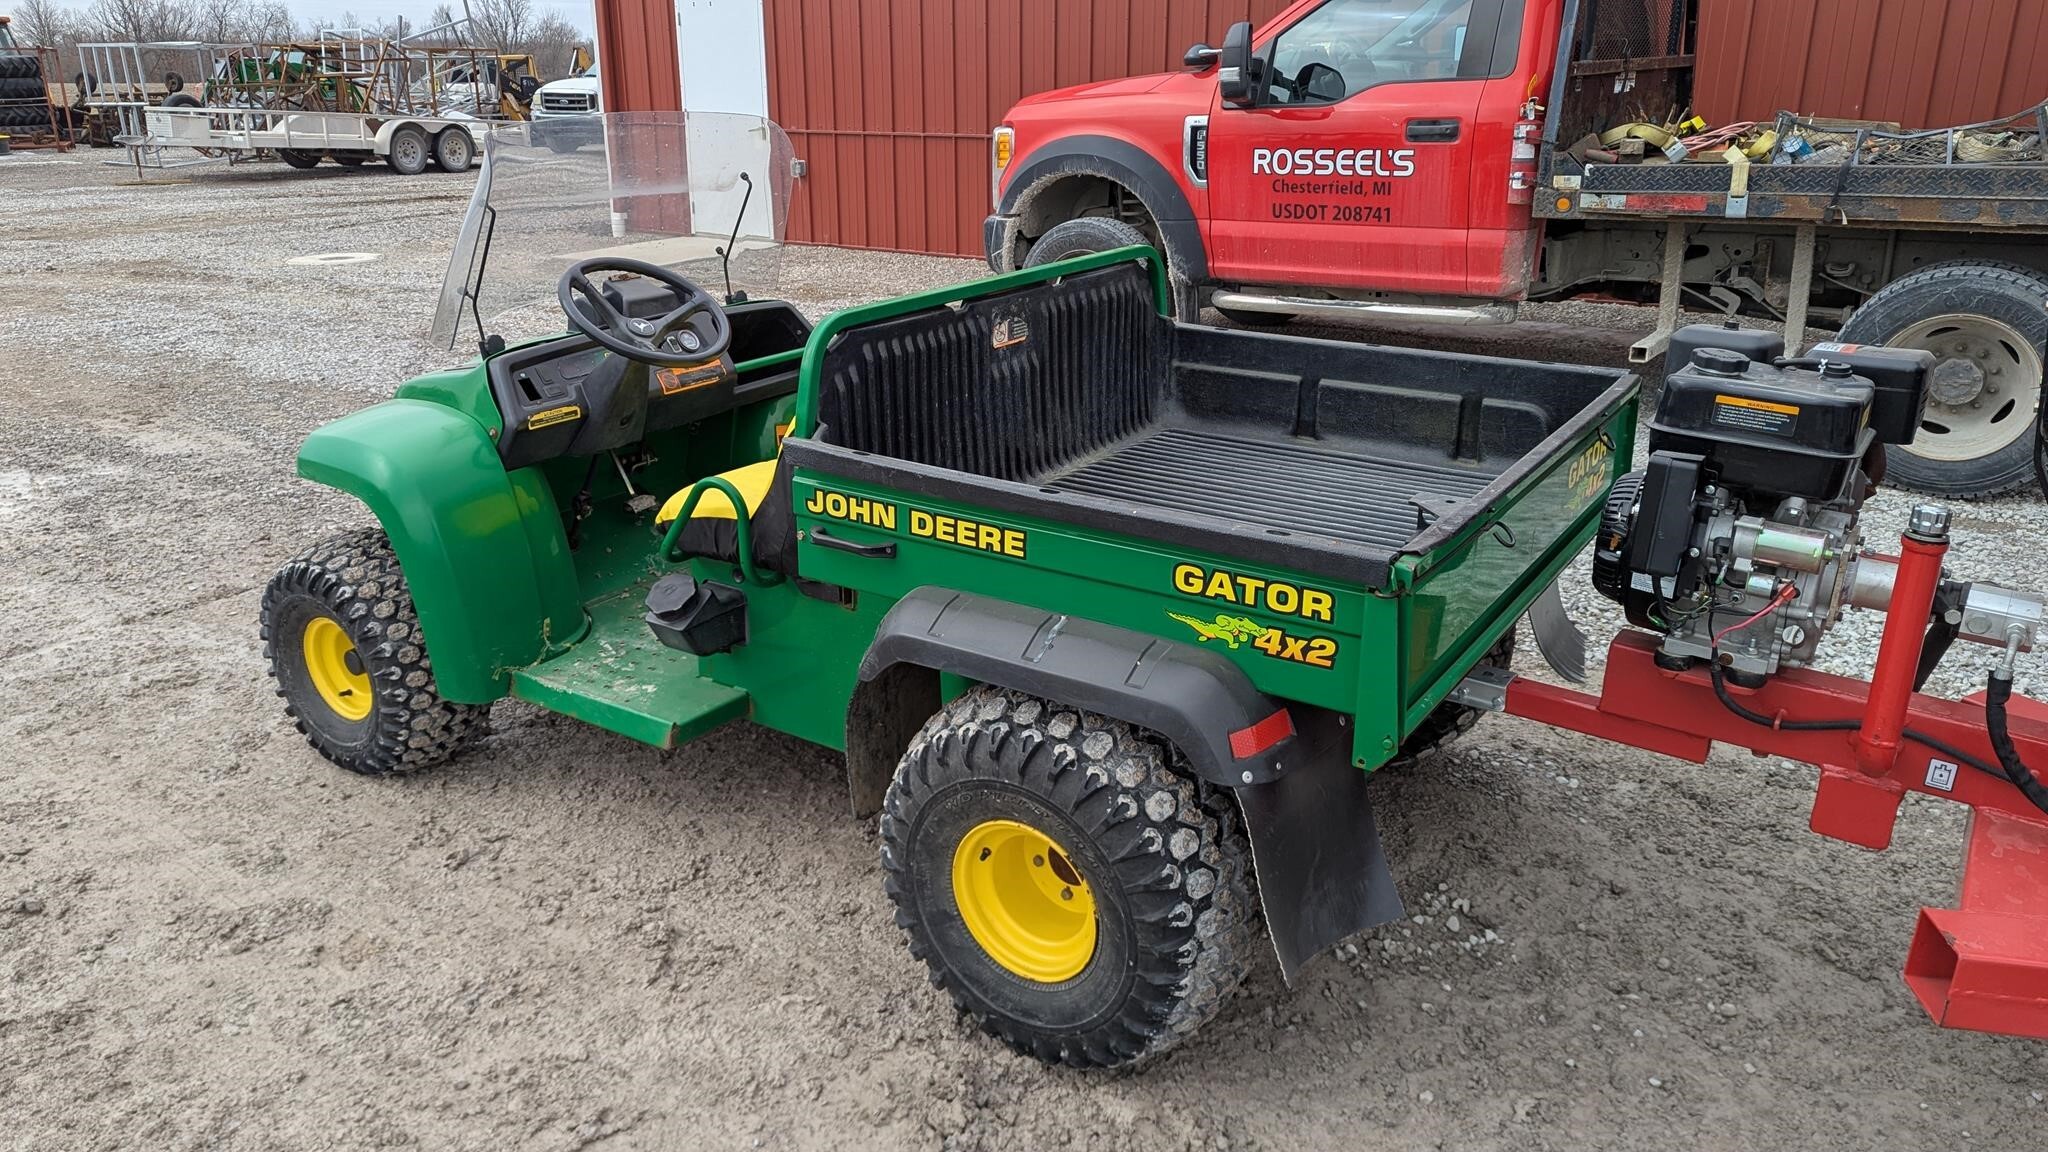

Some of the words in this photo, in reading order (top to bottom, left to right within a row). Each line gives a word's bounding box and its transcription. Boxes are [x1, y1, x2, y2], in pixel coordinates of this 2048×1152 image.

[1197, 129, 1206, 170] F550
[1253, 148, 1416, 177] ROSSEEL'S
[1373, 181, 1392, 196] MI
[1272, 203, 1328, 221] USDOT
[1333, 205, 1391, 223] 208741
[806, 489, 896, 530] JOHN
[910, 510, 1026, 558] DEERE
[1174, 563, 1333, 622] GATOR
[1253, 627, 1337, 668] 4x2
